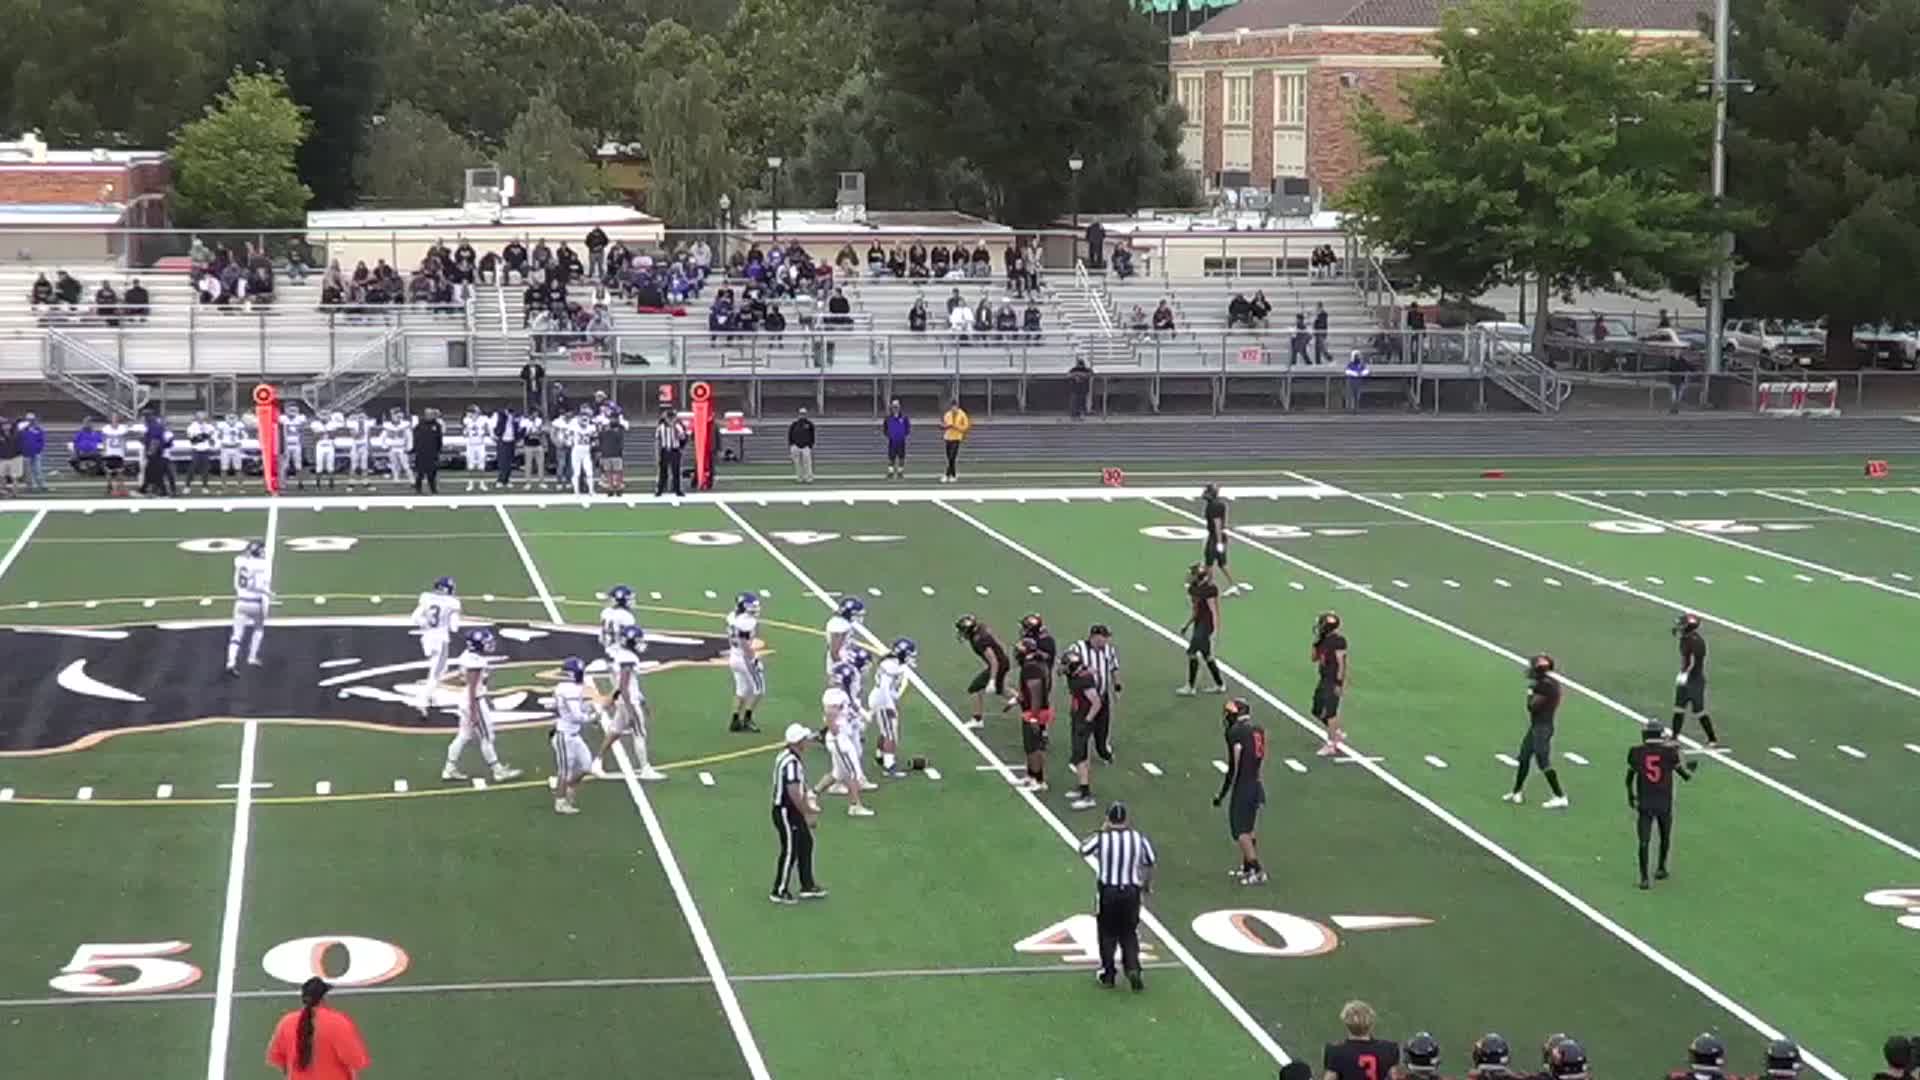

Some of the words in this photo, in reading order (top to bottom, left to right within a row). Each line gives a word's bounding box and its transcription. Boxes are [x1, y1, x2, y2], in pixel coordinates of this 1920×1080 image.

[1104, 468, 1121, 483] 30
[1645, 754, 1662, 783] 5
[48, 935, 410, 993] 50
